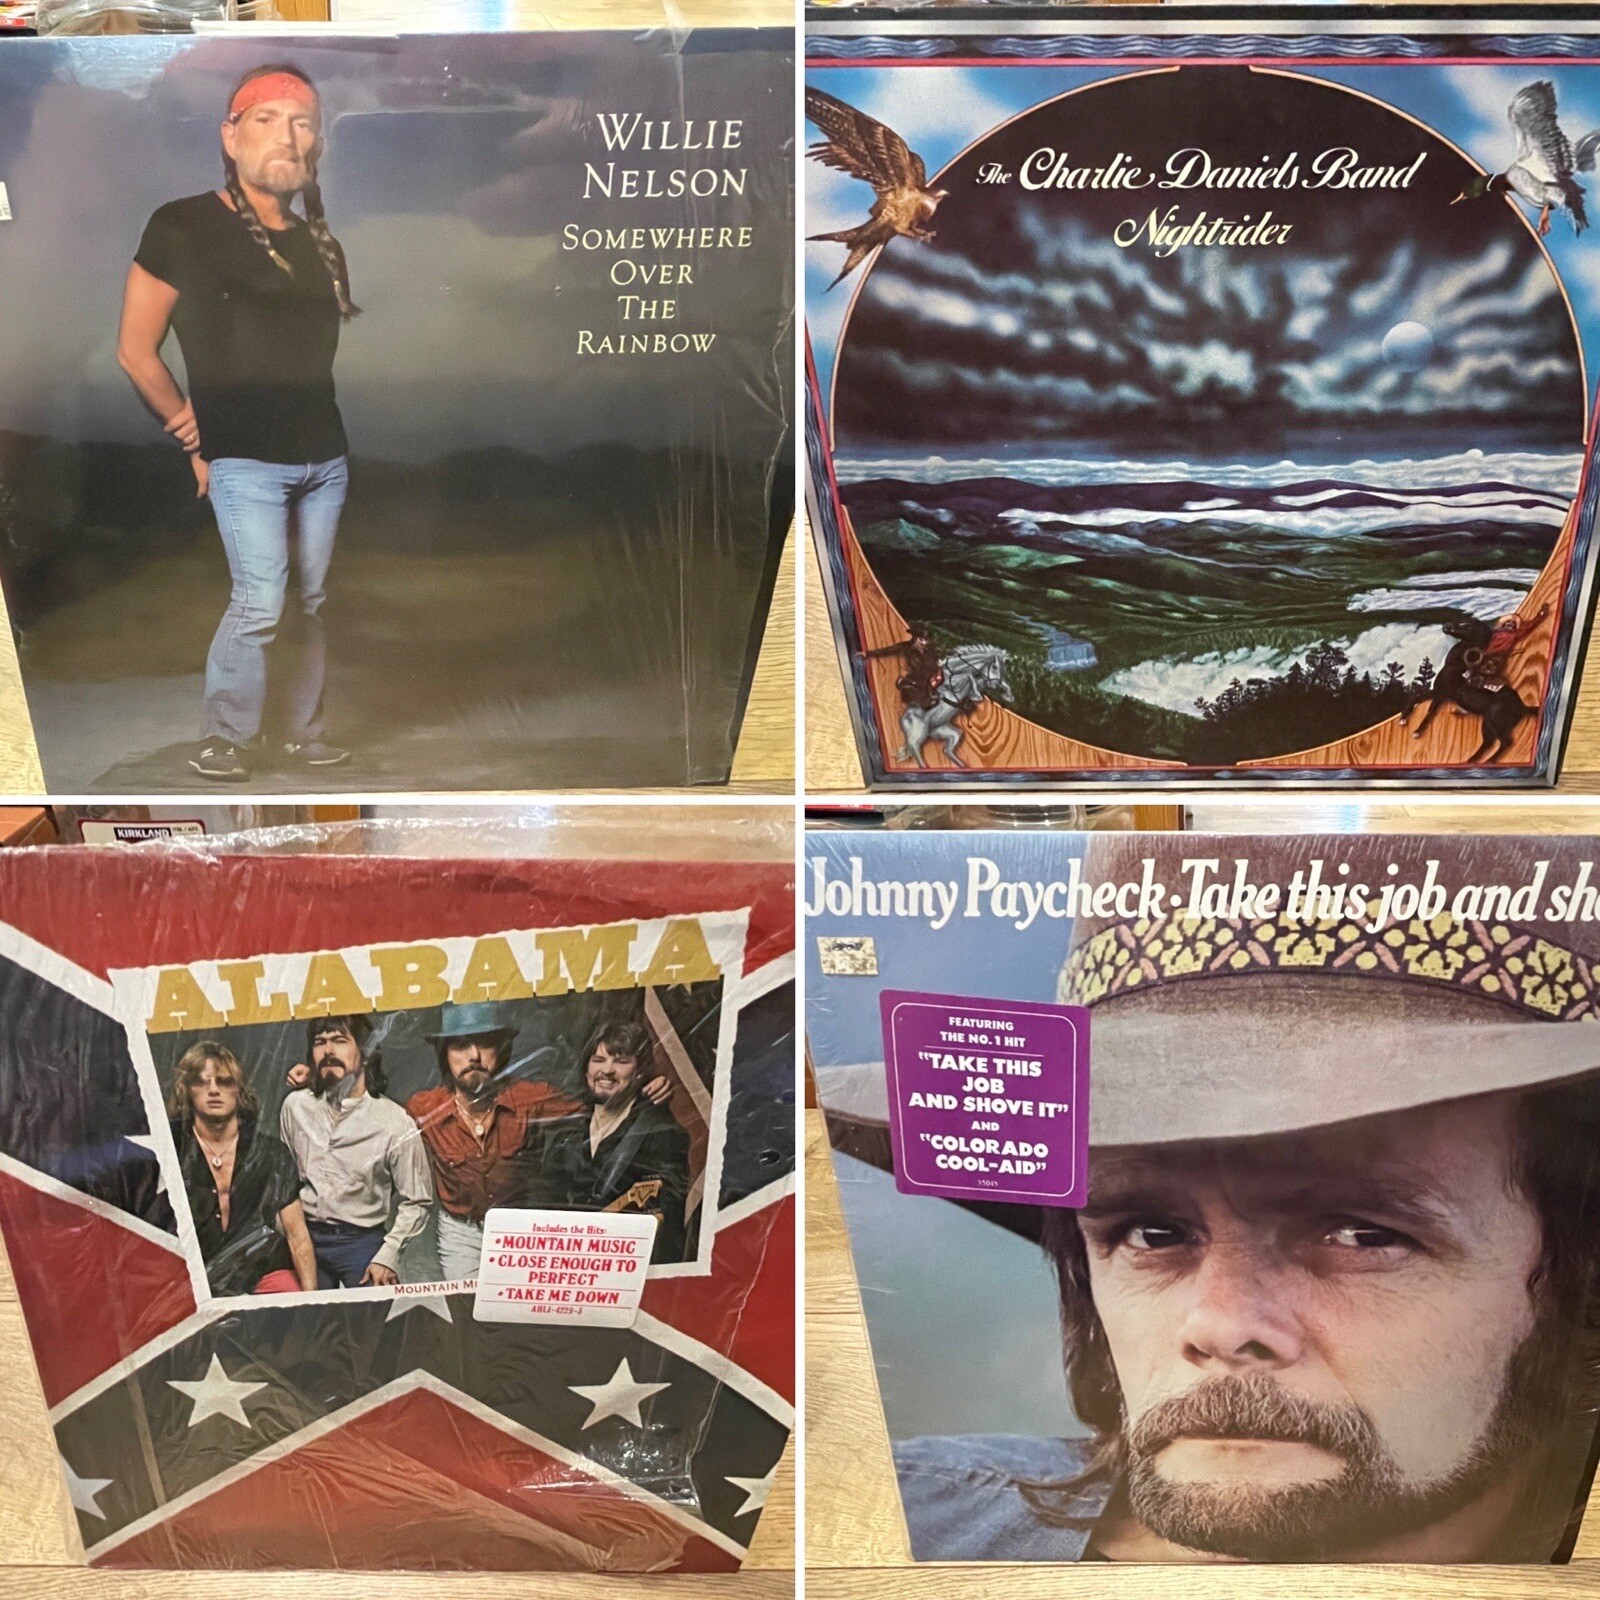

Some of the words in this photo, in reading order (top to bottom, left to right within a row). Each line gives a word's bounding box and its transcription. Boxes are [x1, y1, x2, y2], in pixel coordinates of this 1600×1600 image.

[596, 112, 743, 151] WILLIE
[582, 162, 748, 198] NELSON
[975, 162, 1011, 185] The
[1019, 147, 1155, 191] Charlie
[1157, 147, 1299, 190] Daniels
[1302, 147, 1427, 190] Band
[562, 223, 753, 250] SOMEWHERE
[1113, 205, 1293, 258] Nightrider
[610, 259, 693, 285] OVER
[617, 295, 676, 319] THE
[576, 330, 716, 354] RAINBOW
[117, 828, 169, 838] KIRKLAND
[805, 856, 958, 930] Johnny
[964, 857, 1167, 930] Paycheck
[1181, 858, 1281, 921] Take
[1285, 859, 1370, 922] this
[1365, 860, 1447, 934] job
[1451, 860, 1550, 922] and
[1544, 861, 1600, 922] sh
[146, 917, 723, 1034] ALABAMA
[949, 1016, 1014, 1031] FEATURING
[940, 1031, 965, 1043] THE
[968, 1034, 992, 1045] NO.
[994, 1036, 1001, 1046] 1
[1004, 1036, 1026, 1047] HIT
[918, 1052, 988, 1073] "TAKE
[993, 1058, 1042, 1077] THIS
[962, 1076, 1005, 1094] JOB
[908, 1092, 958, 1110] AND
[963, 1096, 1034, 1116] SHOVE
[971, 1120, 1000, 1131] AND
[532, 1223, 567, 1233] Includes
[570, 1225, 584, 1234] the
[586, 1226, 607, 1235] Hits:
[502, 1236, 582, 1252] MOUNTAIN
[587, 1239, 636, 1254] MUSIC
[498, 1255, 546, 1269] CLOSE
[549, 1257, 611, 1272] ENOUGH
[615, 1260, 637, 1273] TO
[394, 1282, 459, 1295] MOUNTAIN
[528, 1271, 598, 1286] PERFECT
[505, 1288, 545, 1301] TAKE
[548, 1290, 571, 1302] ME
[574, 1291, 619, 1304] DOWN
